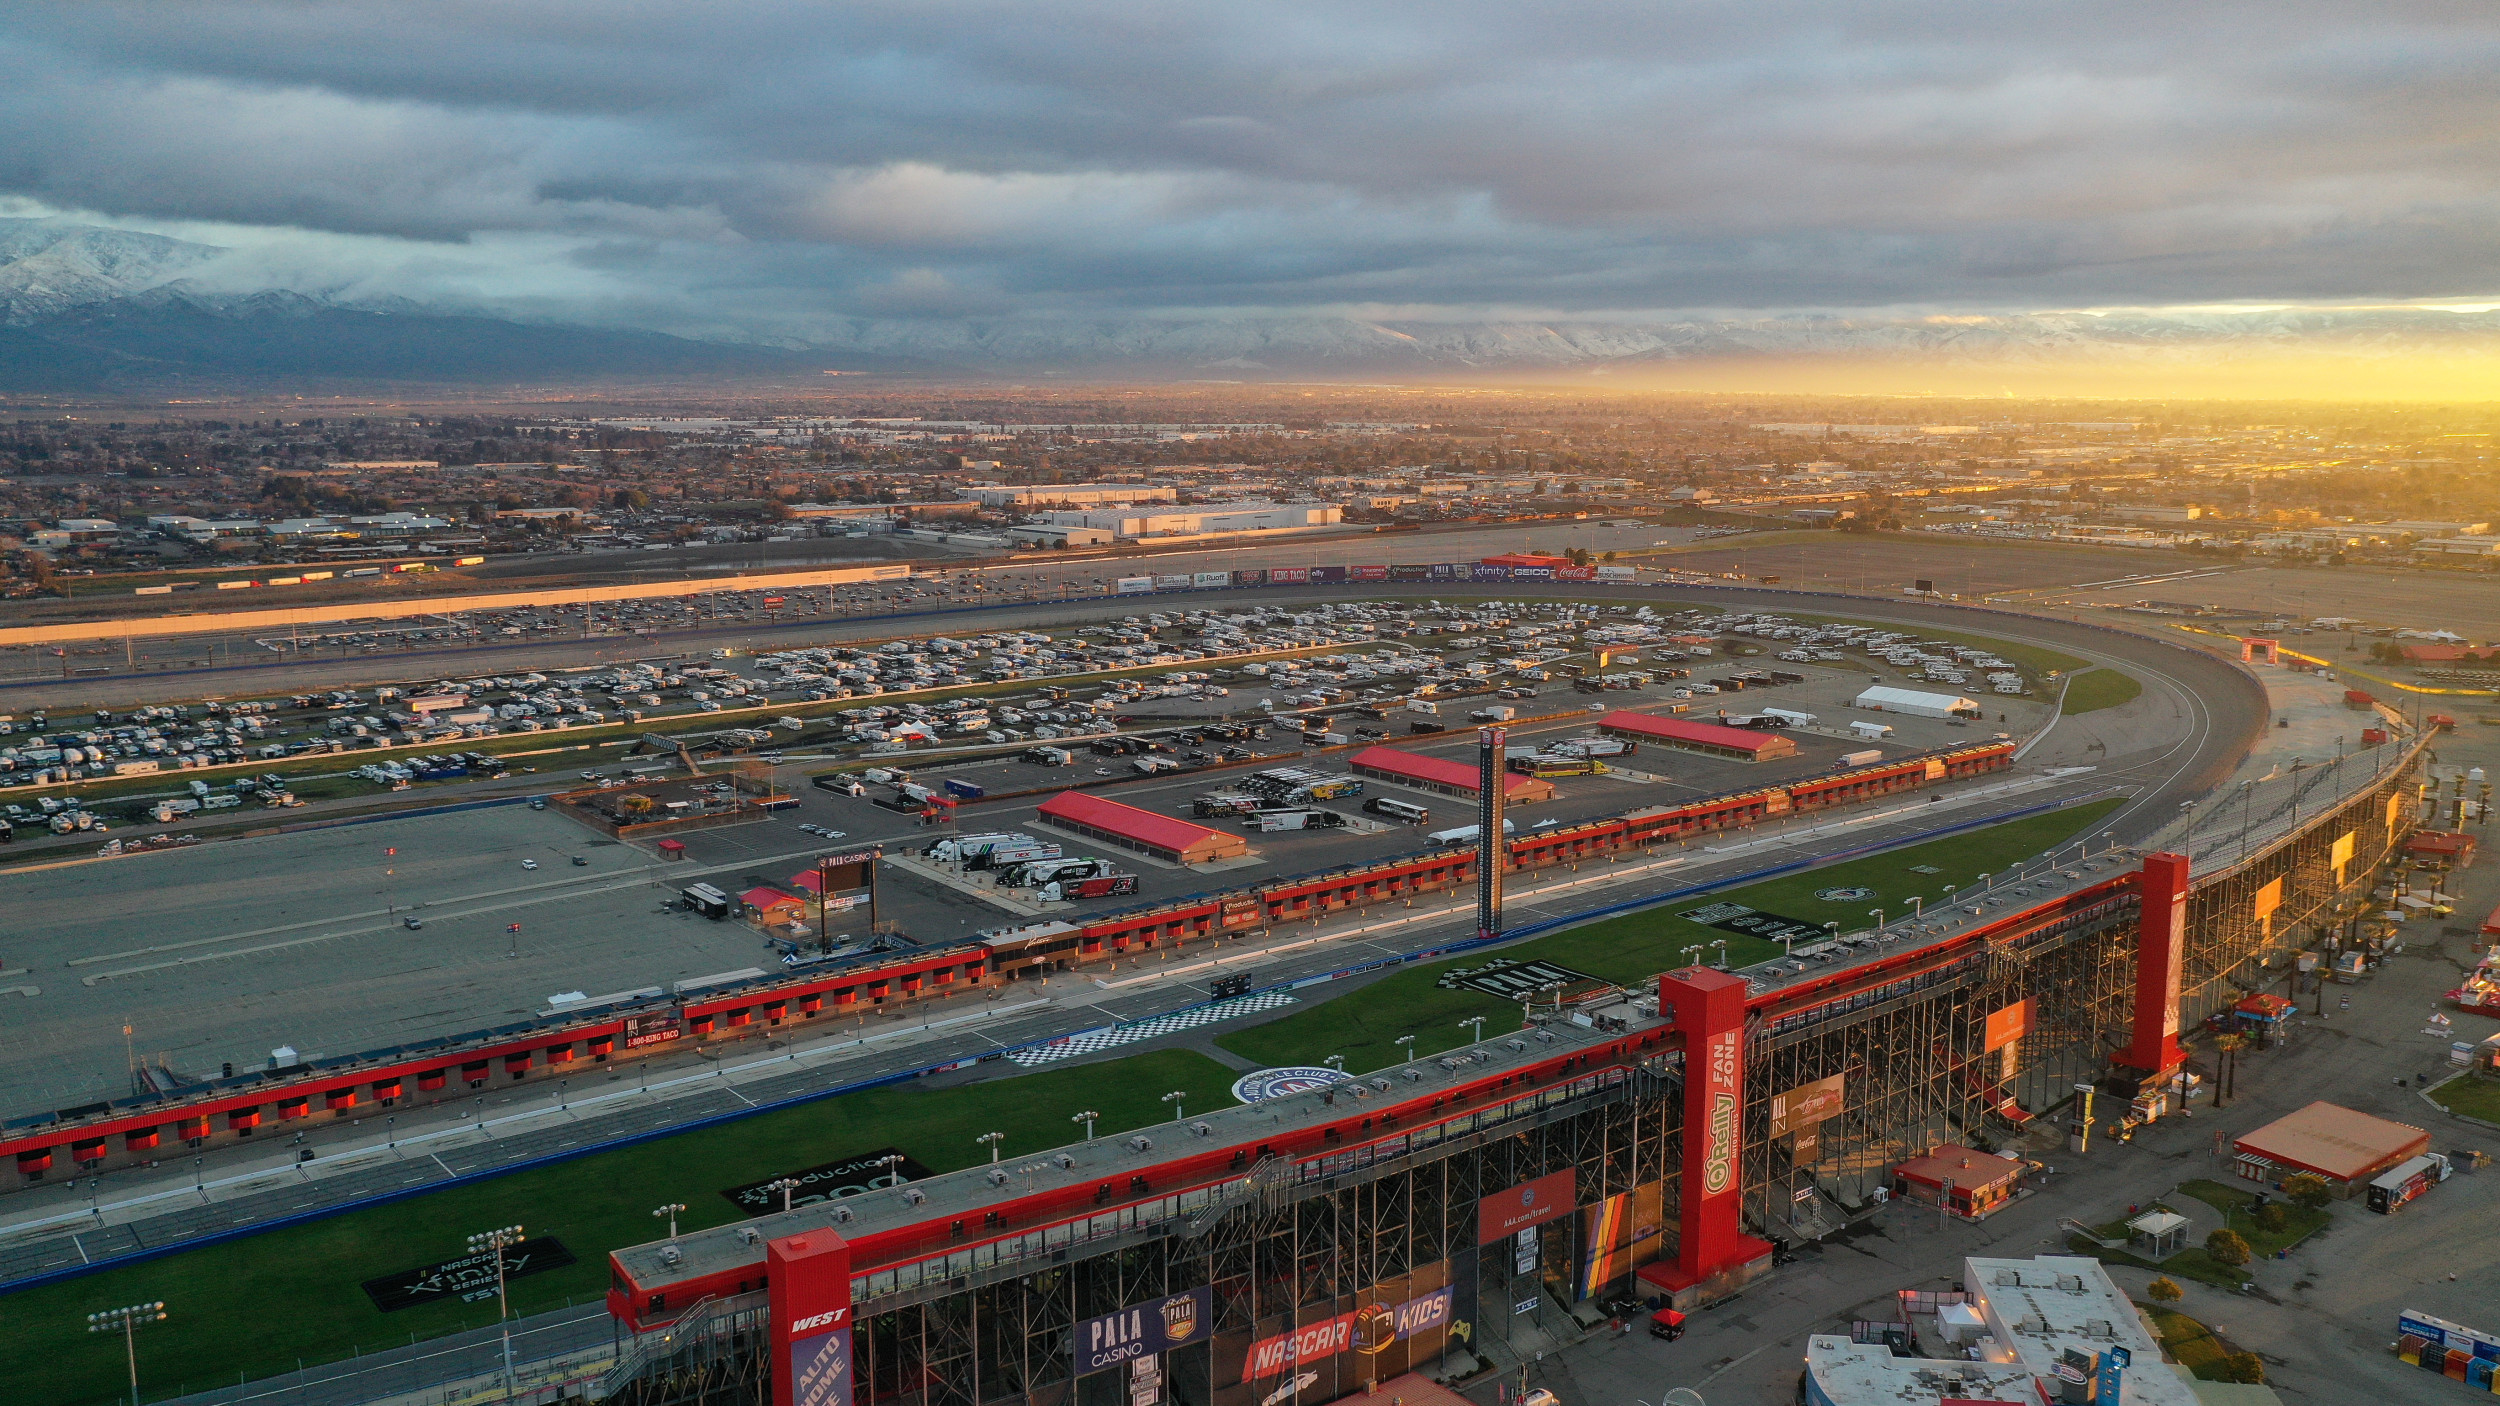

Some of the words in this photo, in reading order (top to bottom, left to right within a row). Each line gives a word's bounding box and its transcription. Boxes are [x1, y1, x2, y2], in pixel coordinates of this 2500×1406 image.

[1206, 573, 1225, 582] Ruoff
[1274, 569, 1288, 580] KING
[1290, 569, 1305, 580] TACO
[1475, 566, 1507, 578] xfinity
[1514, 567, 1549, 576] GEICO
[829, 856, 844, 866] PALA
[844, 852, 872, 863] CASINO
[1229, 899, 1257, 909] Production
[2172, 890, 2186, 902] EAST
[1475, 965, 1567, 992] PALA
[663, 1030, 679, 1040] TACO
[1713, 1044, 1725, 1083] FAN
[1723, 1032, 1736, 1088] ZONE
[1294, 1070, 1329, 1078] CLUB
[1772, 1096, 1786, 1120] ALL
[1772, 1117, 1786, 1135] IN
[1707, 1098, 1734, 1190] O'Reilly
[1796, 1135, 1816, 1151] Coca-Cola
[1503, 1204, 1552, 1229] AAA.com/travel
[404, 1254, 531, 1294] xfinity
[452, 1273, 501, 1291] SERIES
[792, 1308, 847, 1333] WEST
[1170, 1303, 1191, 1321] PALA
[1091, 1309, 1142, 1352] PALA
[1255, 1321, 1348, 1371] NASCAR
[1398, 1295, 1448, 1333] KIDS
[1091, 1342, 1143, 1368] CASINO
[799, 1336, 840, 1394] AUTO
